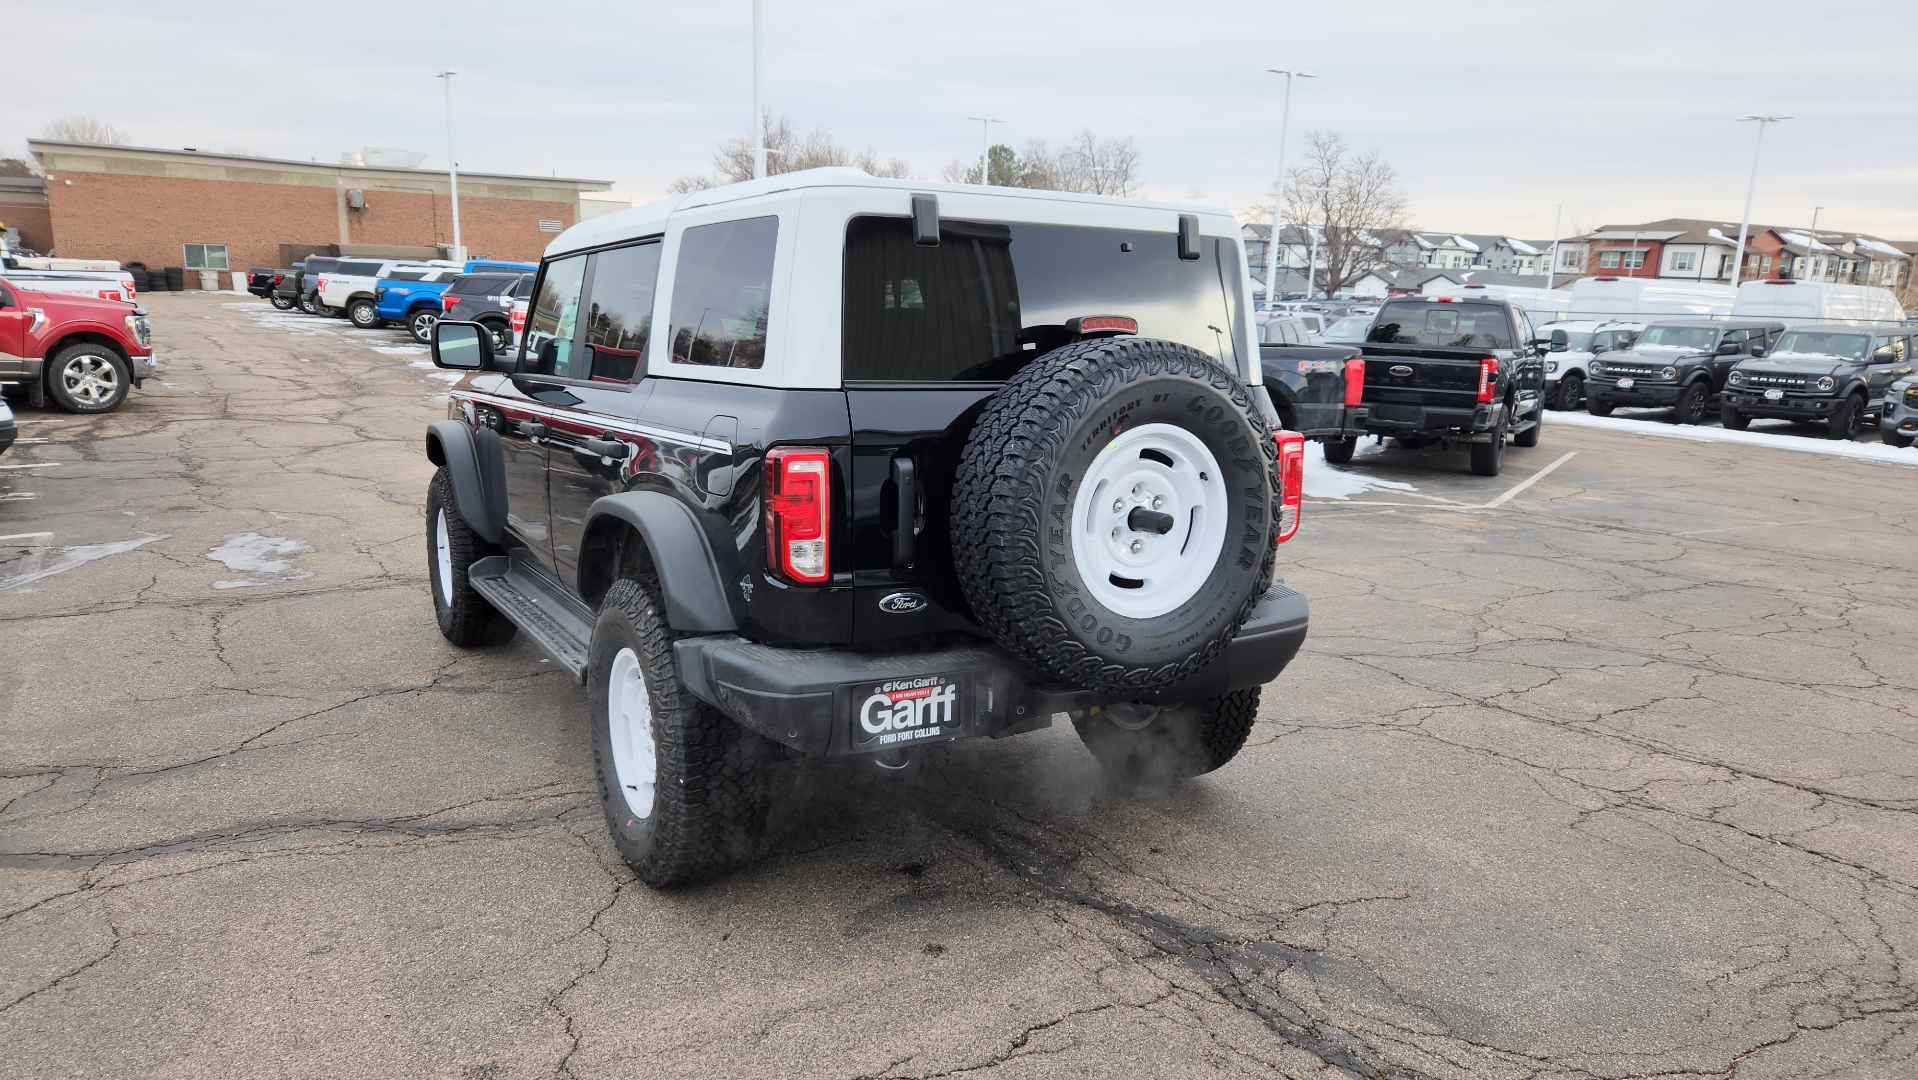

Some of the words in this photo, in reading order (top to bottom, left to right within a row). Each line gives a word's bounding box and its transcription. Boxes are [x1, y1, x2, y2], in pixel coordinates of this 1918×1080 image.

[1298, 361, 1336, 371] FX4
[1750, 376, 1806, 384] BRONCO
[1080, 398, 1142, 452] TERRITORY
[1187, 395, 1265, 572] GOODYEAR
[1048, 473, 1132, 654] GOODYEAR
[892, 680, 913, 691] Ken
[913, 676, 938, 688] Garff
[860, 684, 956, 734] Garff
[880, 733, 897, 744] FORD
[898, 730, 914, 742] FORT
[915, 726, 940, 738] COLLINS
